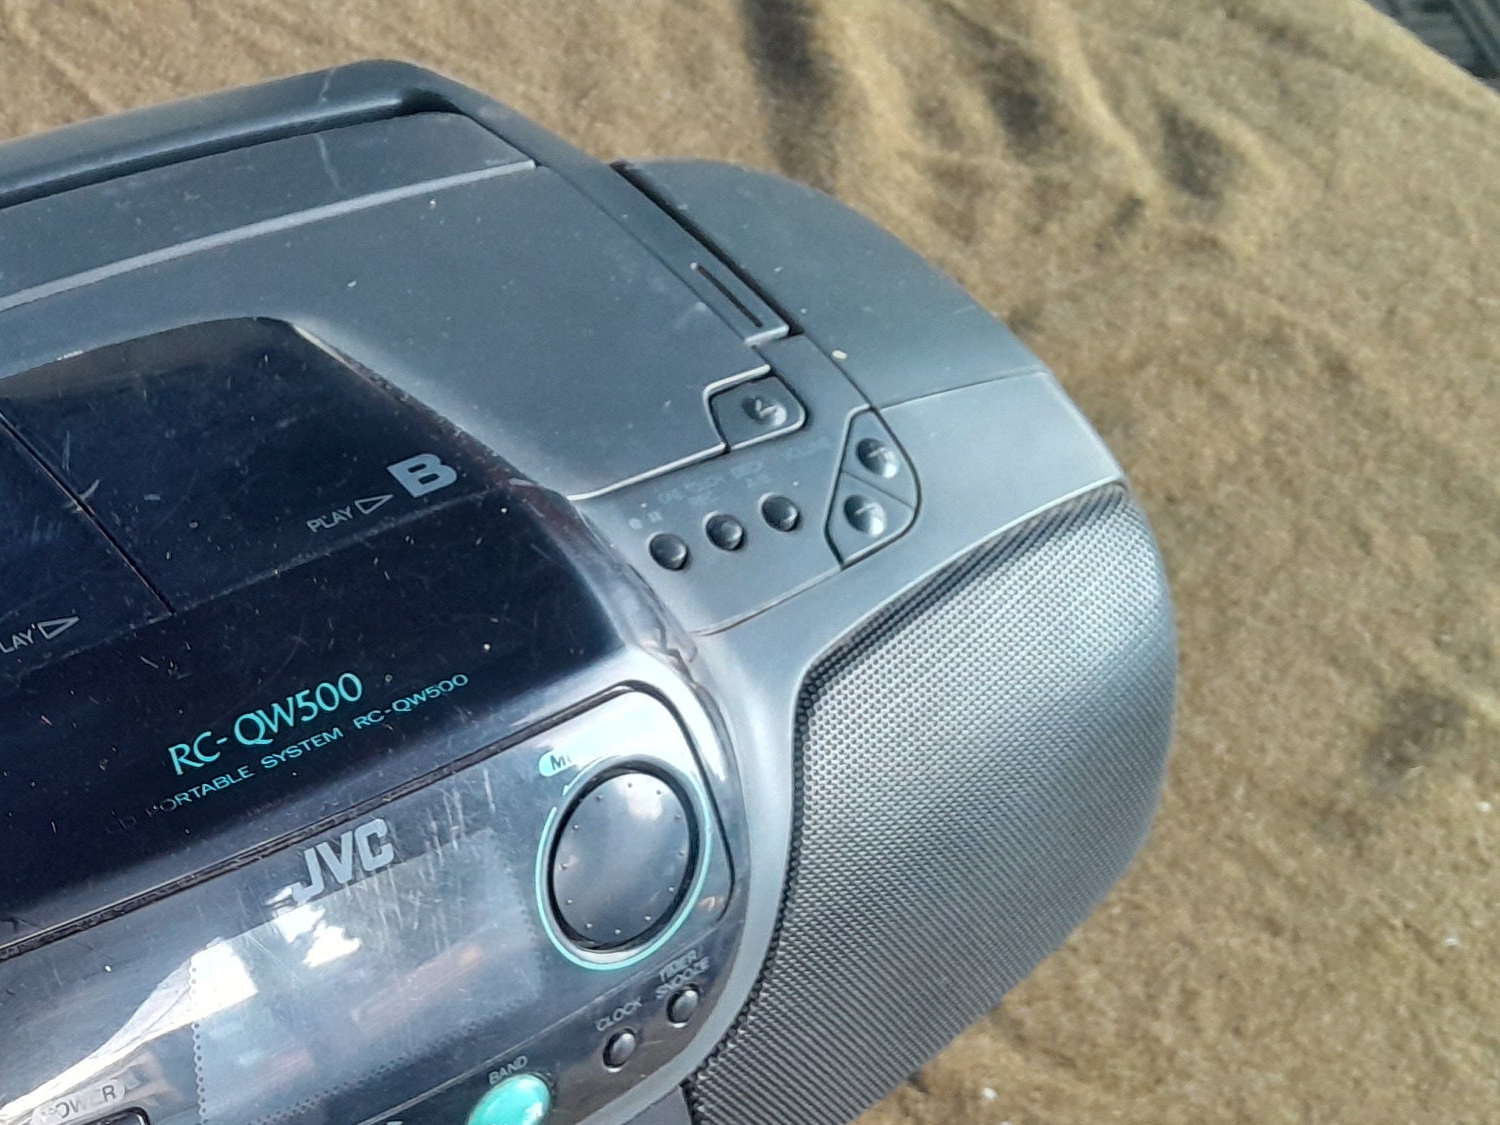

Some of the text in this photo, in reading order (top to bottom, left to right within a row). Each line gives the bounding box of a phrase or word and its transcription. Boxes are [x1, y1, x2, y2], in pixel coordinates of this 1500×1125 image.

[306, 454, 458, 533] PLAY B
[167, 673, 363, 776] RC-QW500
[260, 727, 344, 770] SYSTEM
[353, 673, 469, 729] RC-QW500
[290, 818, 395, 905] JVC
[596, 997, 642, 1032] CLOCK
[489, 1055, 528, 1085] BAND
